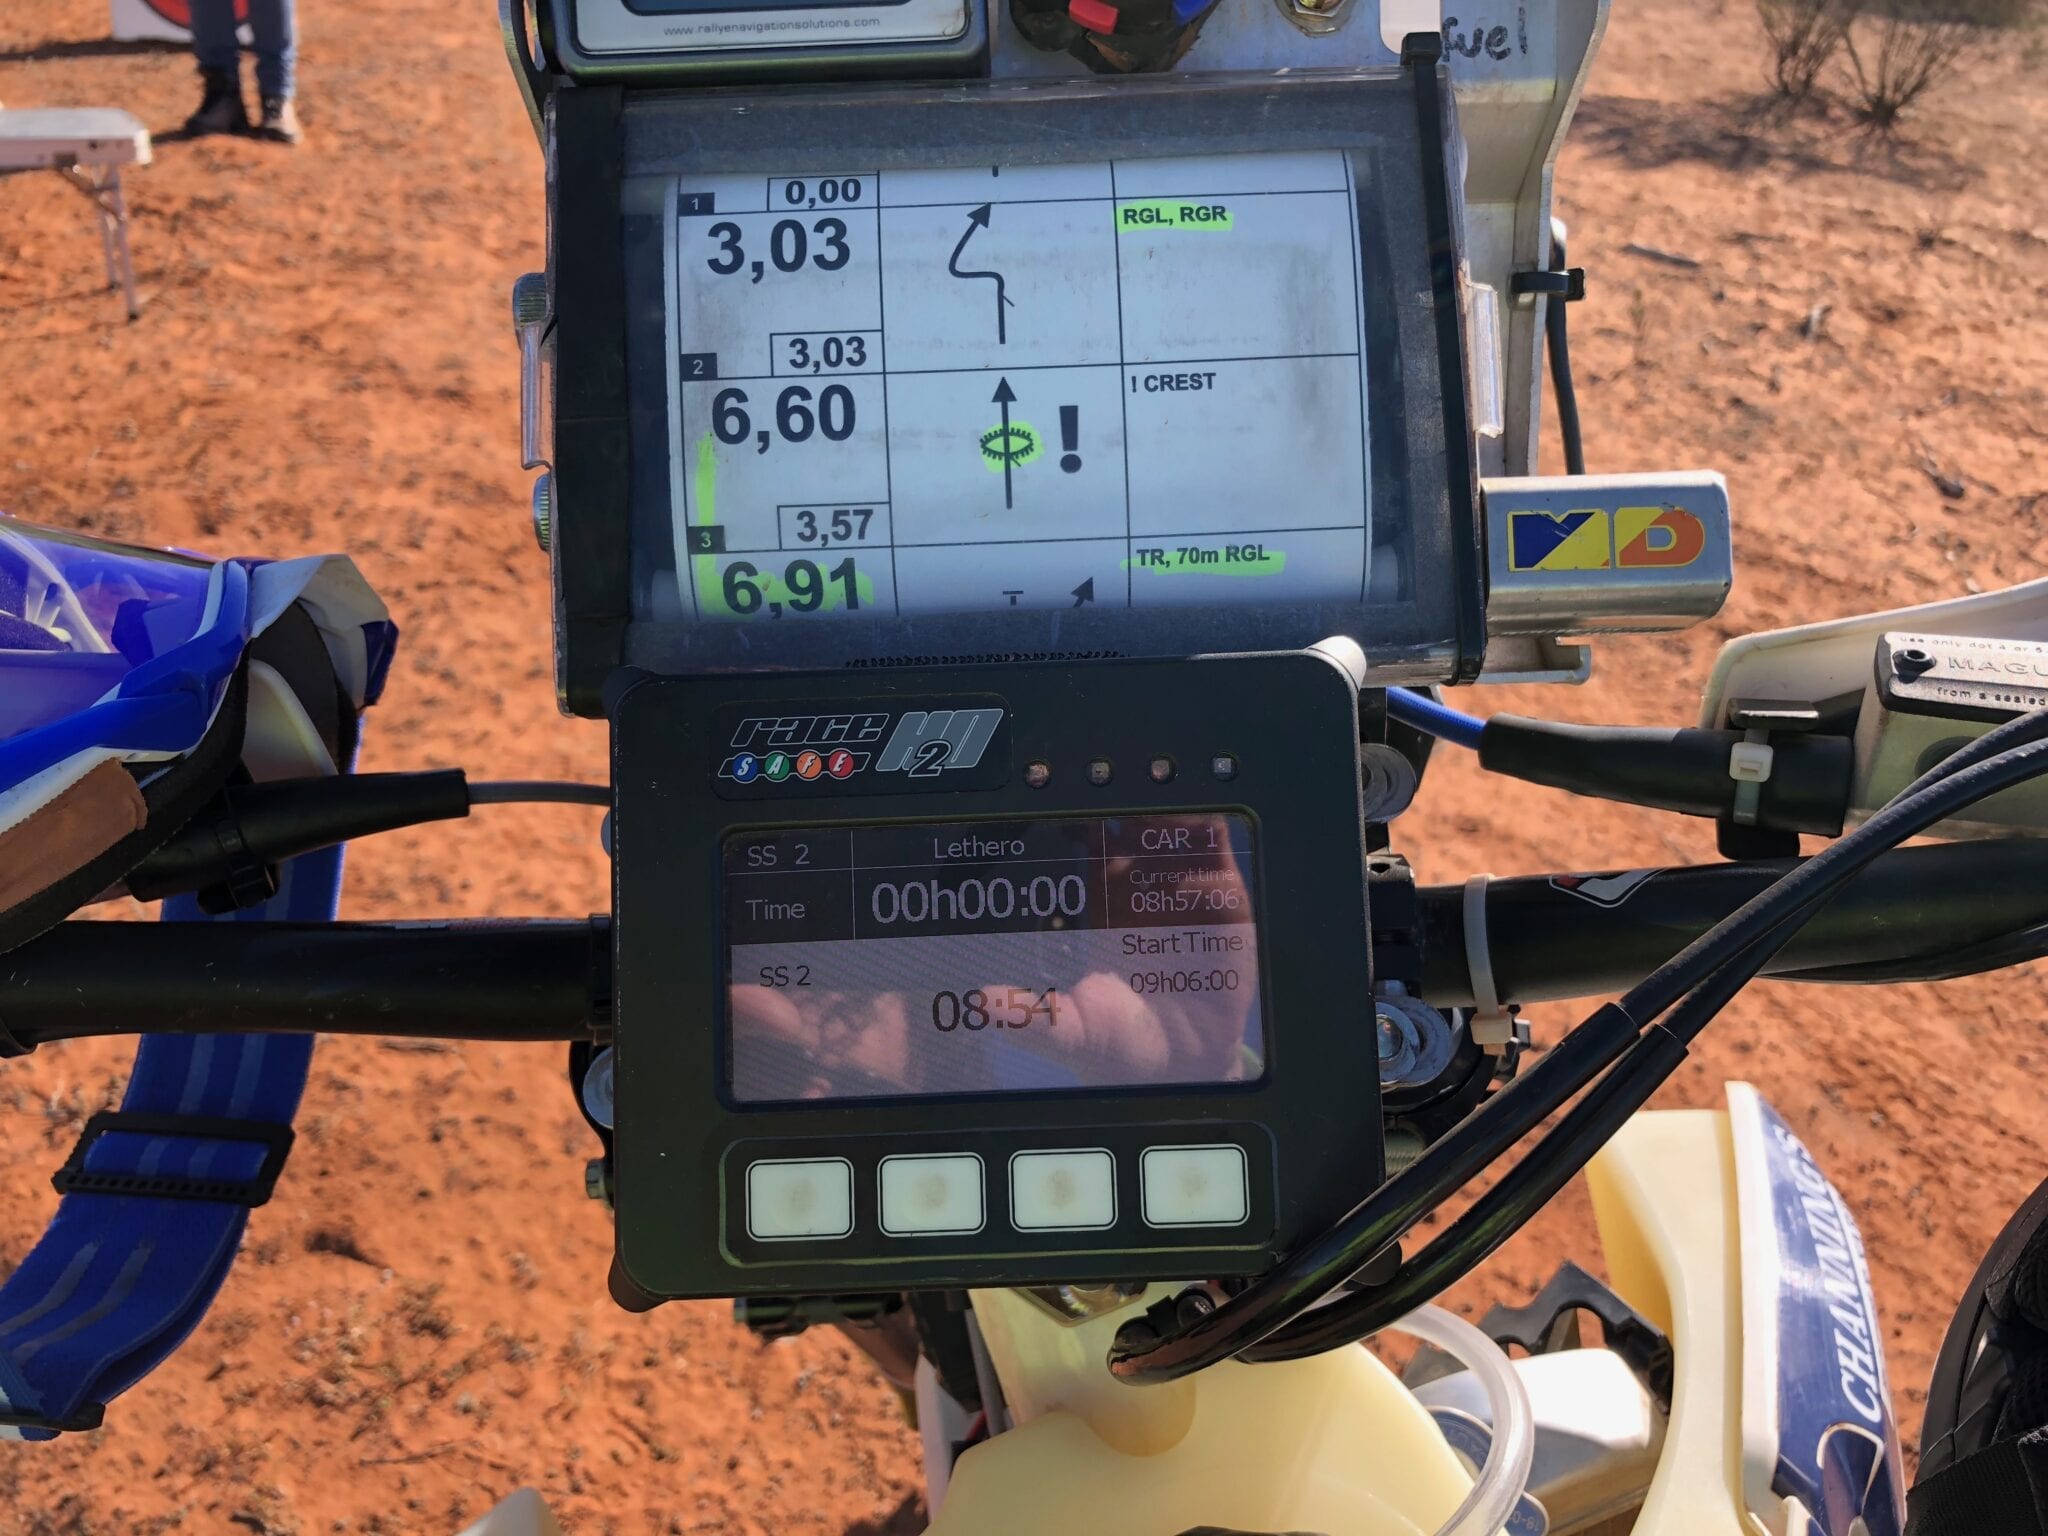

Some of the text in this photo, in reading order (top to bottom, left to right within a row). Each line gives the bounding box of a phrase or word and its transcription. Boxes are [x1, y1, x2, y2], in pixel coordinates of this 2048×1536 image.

[663, 17, 880, 36] www.rallyenavigationsolutions.com
[691, 198, 700, 210] 1
[785, 178, 862, 209] 0,00
[1123, 205, 1227, 227] RGL, RGR
[707, 217, 851, 284] 3,03
[692, 359, 703, 375] 2
[789, 336, 867, 374] 3,03
[1131, 372, 1216, 392] ! CREST
[712, 384, 856, 455] 6,60
[701, 532, 712, 548] 3
[796, 509, 874, 547] 3,57
[1136, 544, 1270, 568] TR, 70m RGL
[722, 557, 860, 620] 6,91
[1937, 686, 2047, 706] from a sealed
[730, 713, 889, 747] race
[734, 752, 852, 780] SAFE
[934, 835, 1025, 859] Lethero
[1141, 828, 1192, 850] CAR
[747, 844, 810, 867] SS 2
[1130, 868, 1197, 884] Current
[745, 898, 806, 920] Time
[872, 875, 1086, 923] 00h00:00
[1131, 888, 1239, 912] 08h57:06
[1122, 932, 1244, 955] Start Time
[760, 965, 811, 987] SS 2
[1130, 969, 1239, 993] 09h06:00
[932, 987, 1061, 1032] 08:54
